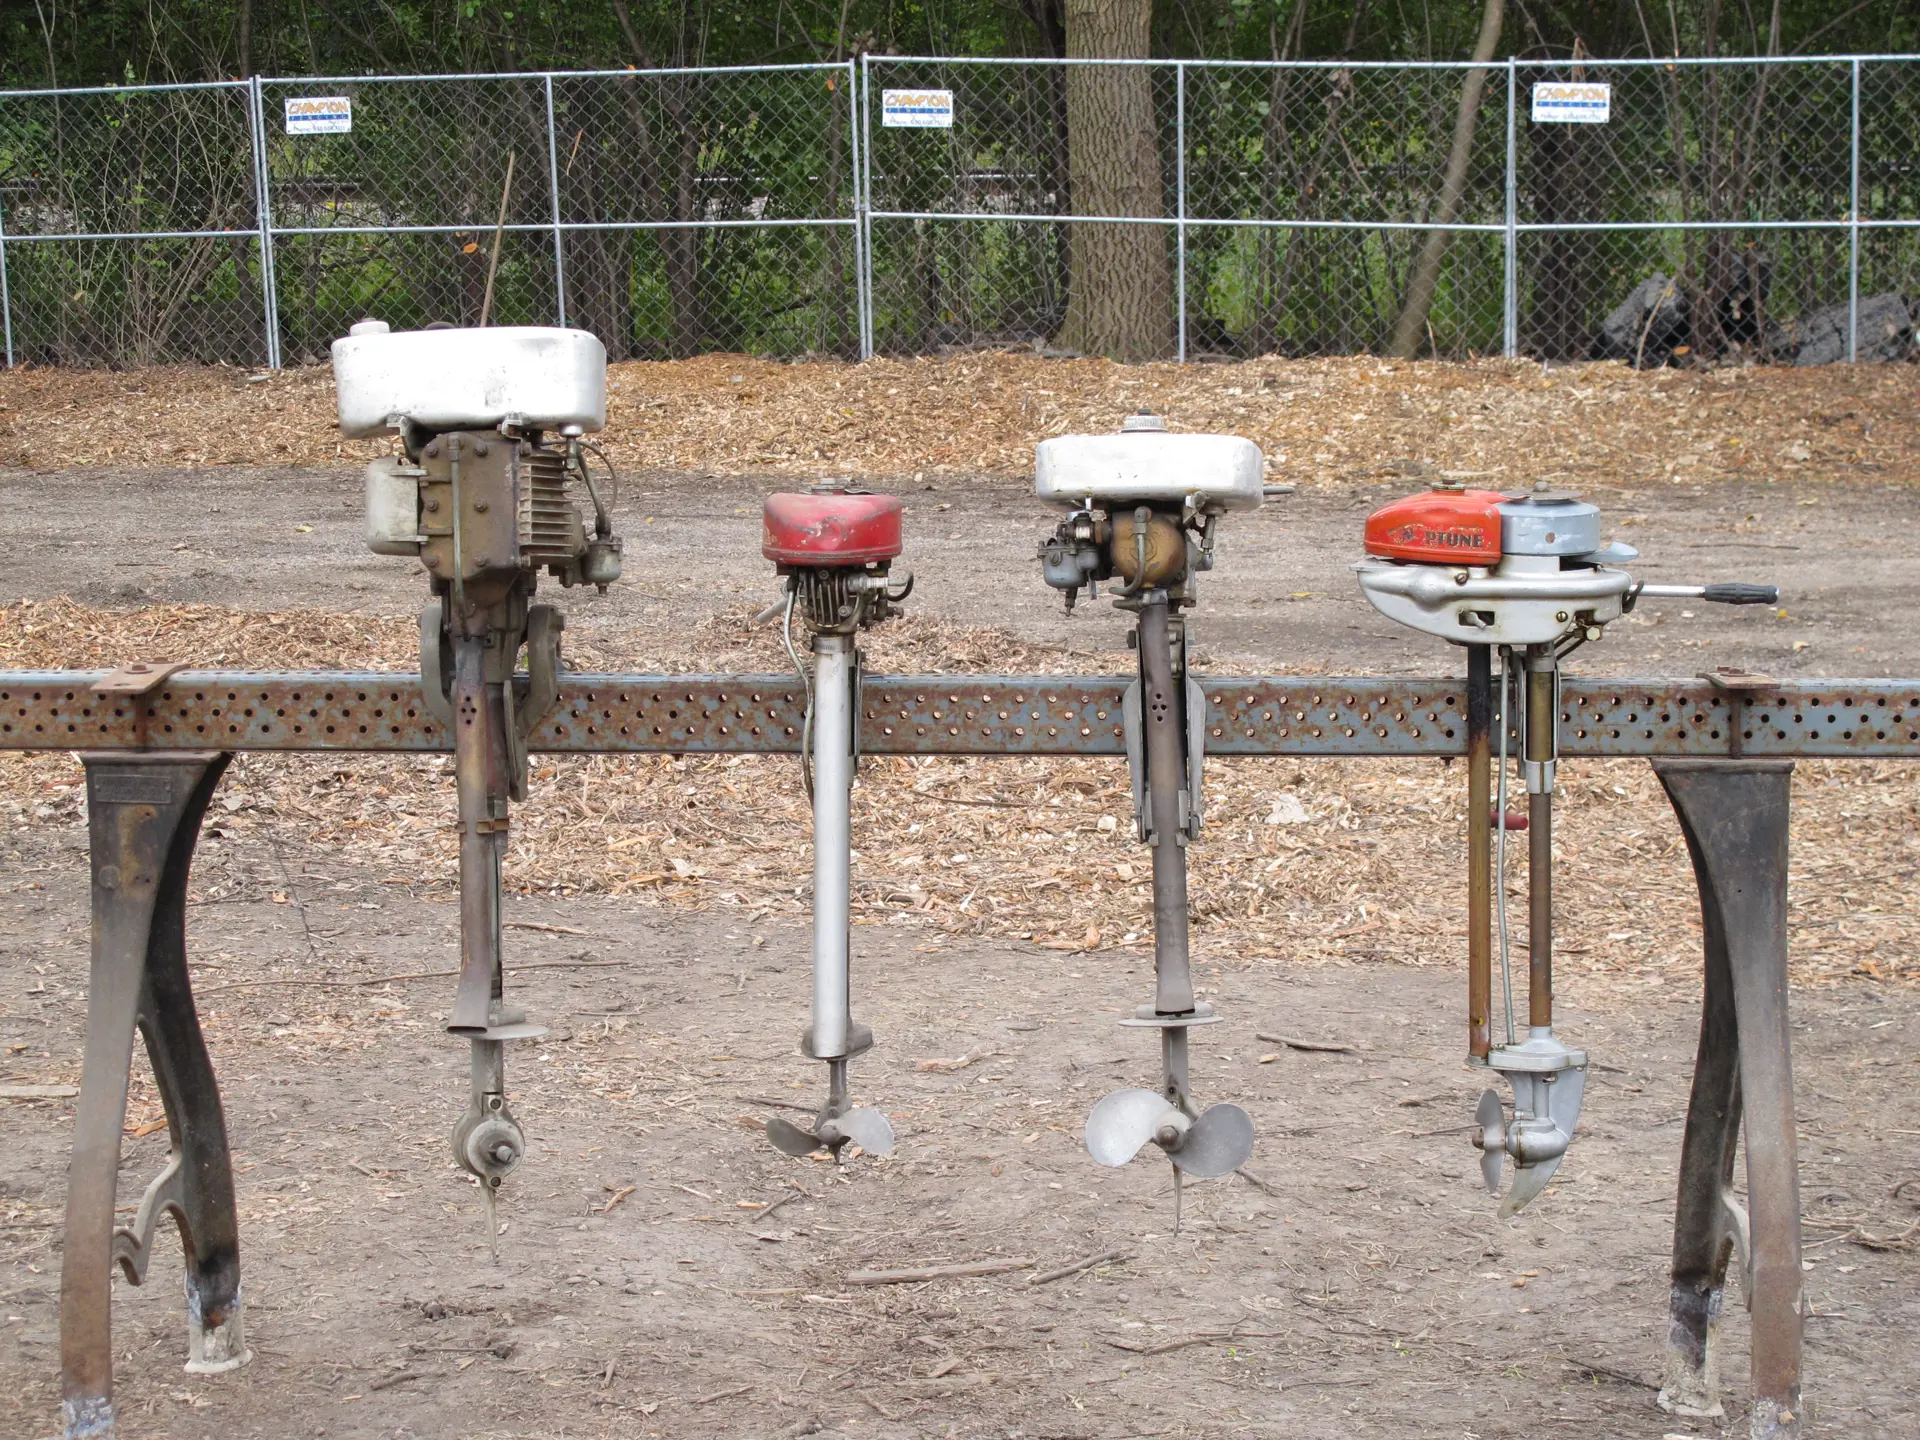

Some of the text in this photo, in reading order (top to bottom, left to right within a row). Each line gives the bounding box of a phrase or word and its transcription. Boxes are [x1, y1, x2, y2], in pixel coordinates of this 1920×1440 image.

[885, 94, 950, 107] CHAMPION
[288, 101, 349, 114] CHAMPION
[1402, 527, 1483, 548] NPTUNE
